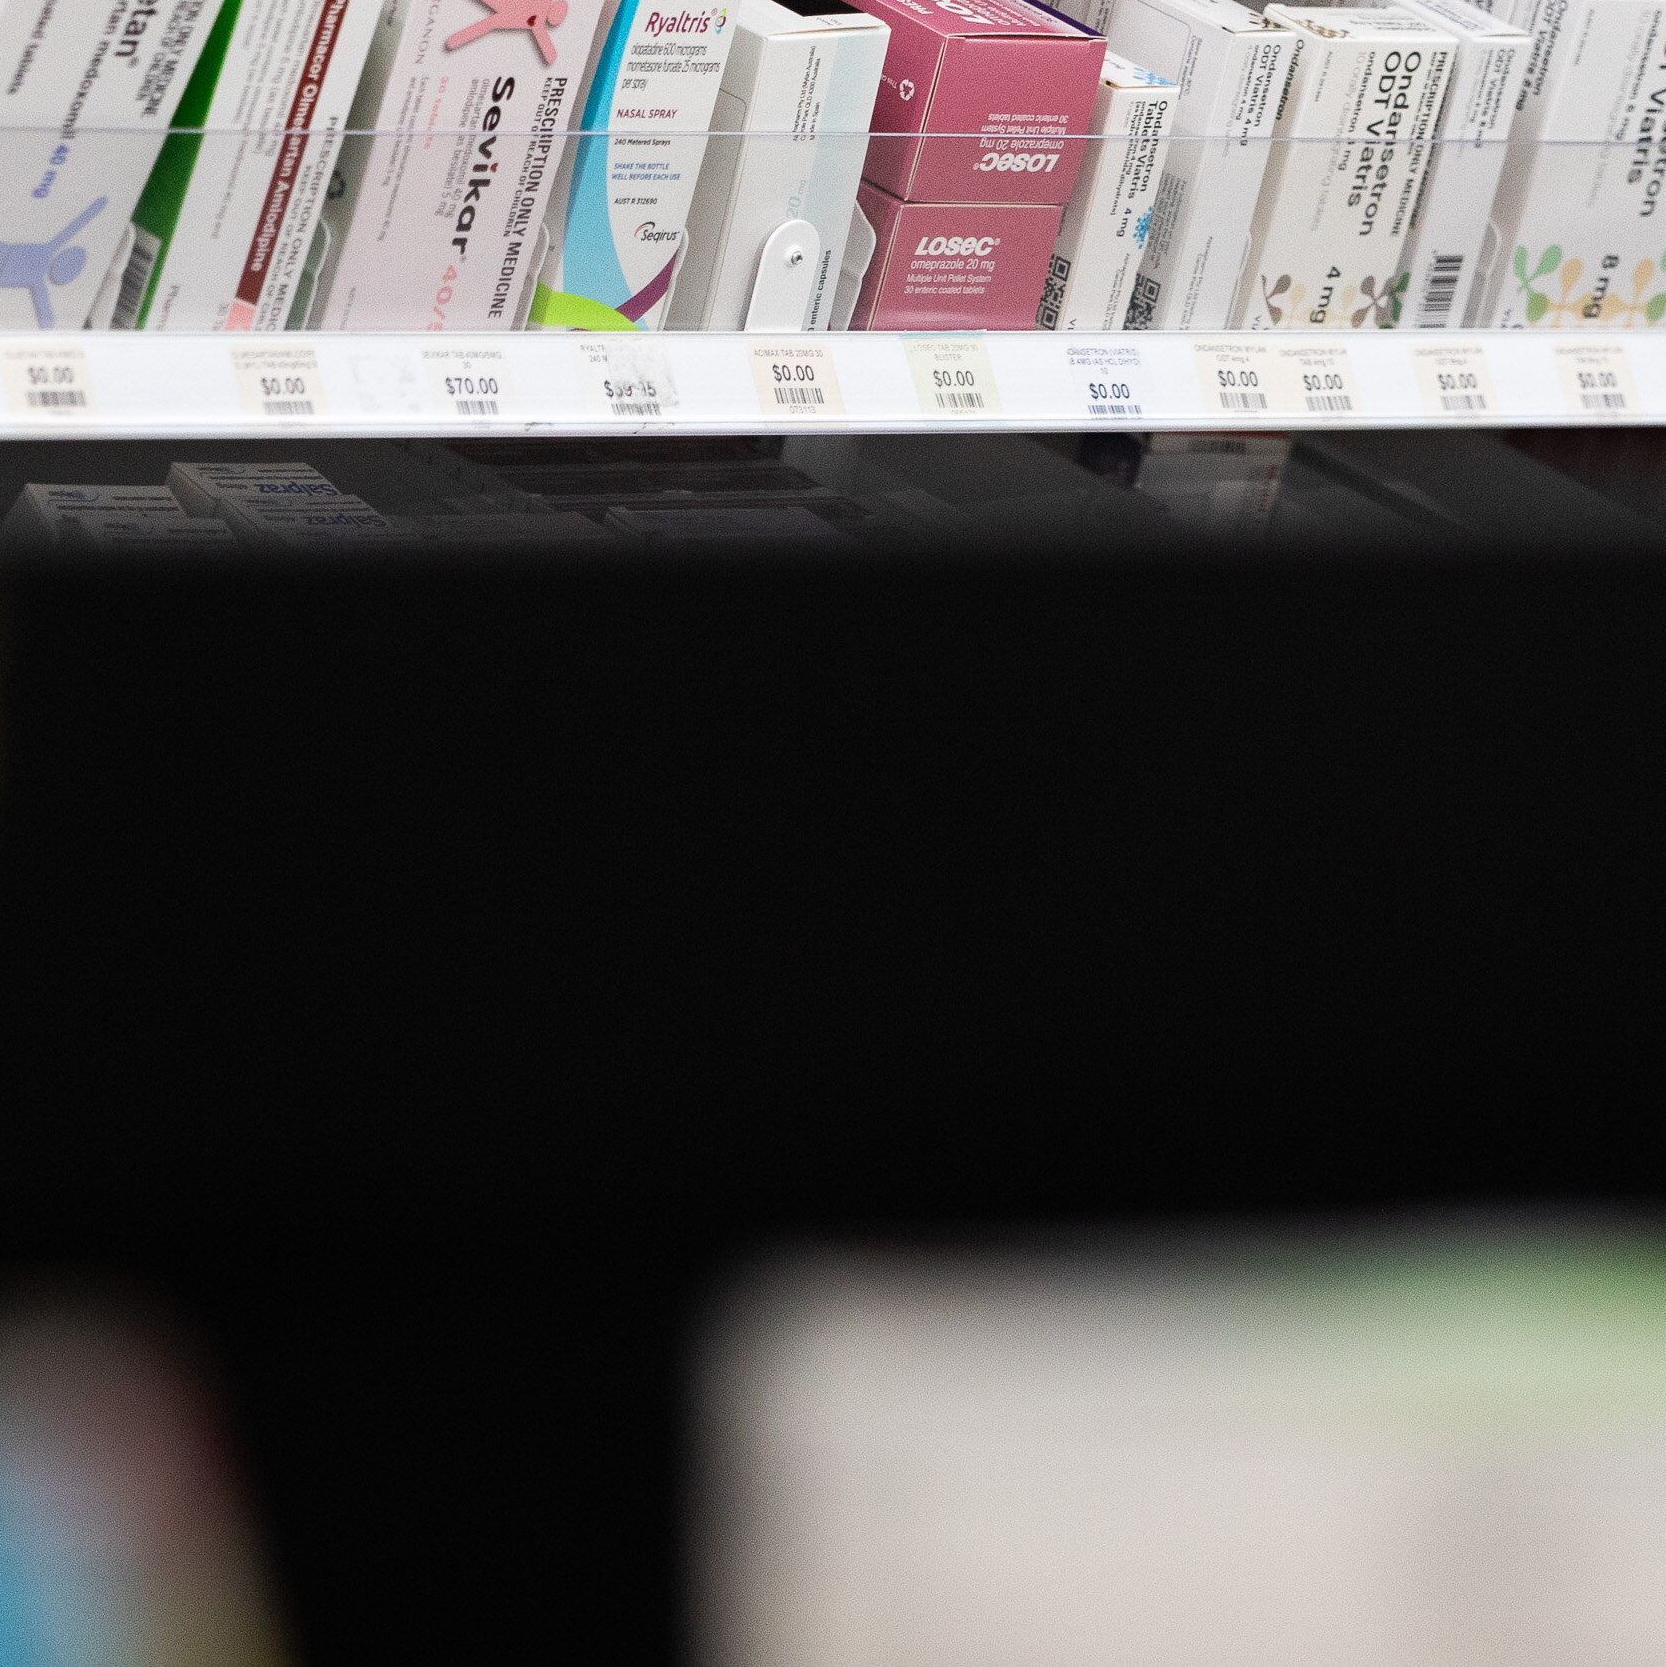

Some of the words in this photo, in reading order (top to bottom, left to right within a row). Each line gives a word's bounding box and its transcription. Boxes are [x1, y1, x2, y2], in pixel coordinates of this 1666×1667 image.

[60, 40, 111, 139] medoxomil
[1253, 44, 1281, 127] Ondansetron
[1374, 51, 1402, 109] ODT
[280, 84, 319, 178] Olmesartan
[616, 109, 647, 119] NASAL
[648, 109, 677, 119] SPRAY
[1137, 100, 1159, 154] Tablets
[49, 144, 70, 165] 40
[529, 77, 568, 195] PRESCRIPTION
[614, 138, 627, 146] 240
[628, 138, 651, 146] Metered
[652, 139, 671, 147] Sprays
[1140, 100, 1168, 192] Ondansetron
[1359, 51, 1421, 236] Ondansetron
[32, 170, 57, 199] mg
[1128, 155, 1147, 199] Viatris
[251, 182, 287, 273] Amlodipine
[514, 196, 536, 238] ONLY
[1116, 218, 1129, 238] mg
[1124, 206, 1132, 216] 4
[488, 239, 522, 320] MEDICINE
[911, 259, 965, 271] omeprazole
[966, 259, 978, 270] 20
[980, 260, 995, 272] mg
[1326, 266, 1342, 279] 4
[810, 293, 824, 324] enteric
[818, 249, 832, 292] capsules
[904, 286, 913, 294] 30
[914, 286, 937, 295] enteric
[938, 286, 962, 295] coated
[963, 286, 985, 295] tablets
[1310, 286, 1334, 325] mg
[1581, 277, 1609, 320] mg
[444, 375, 500, 397] $70.00
[772, 363, 816, 384] $0.00
[932, 368, 976, 389] $0.00
[1089, 382, 1131, 400] $0.00
